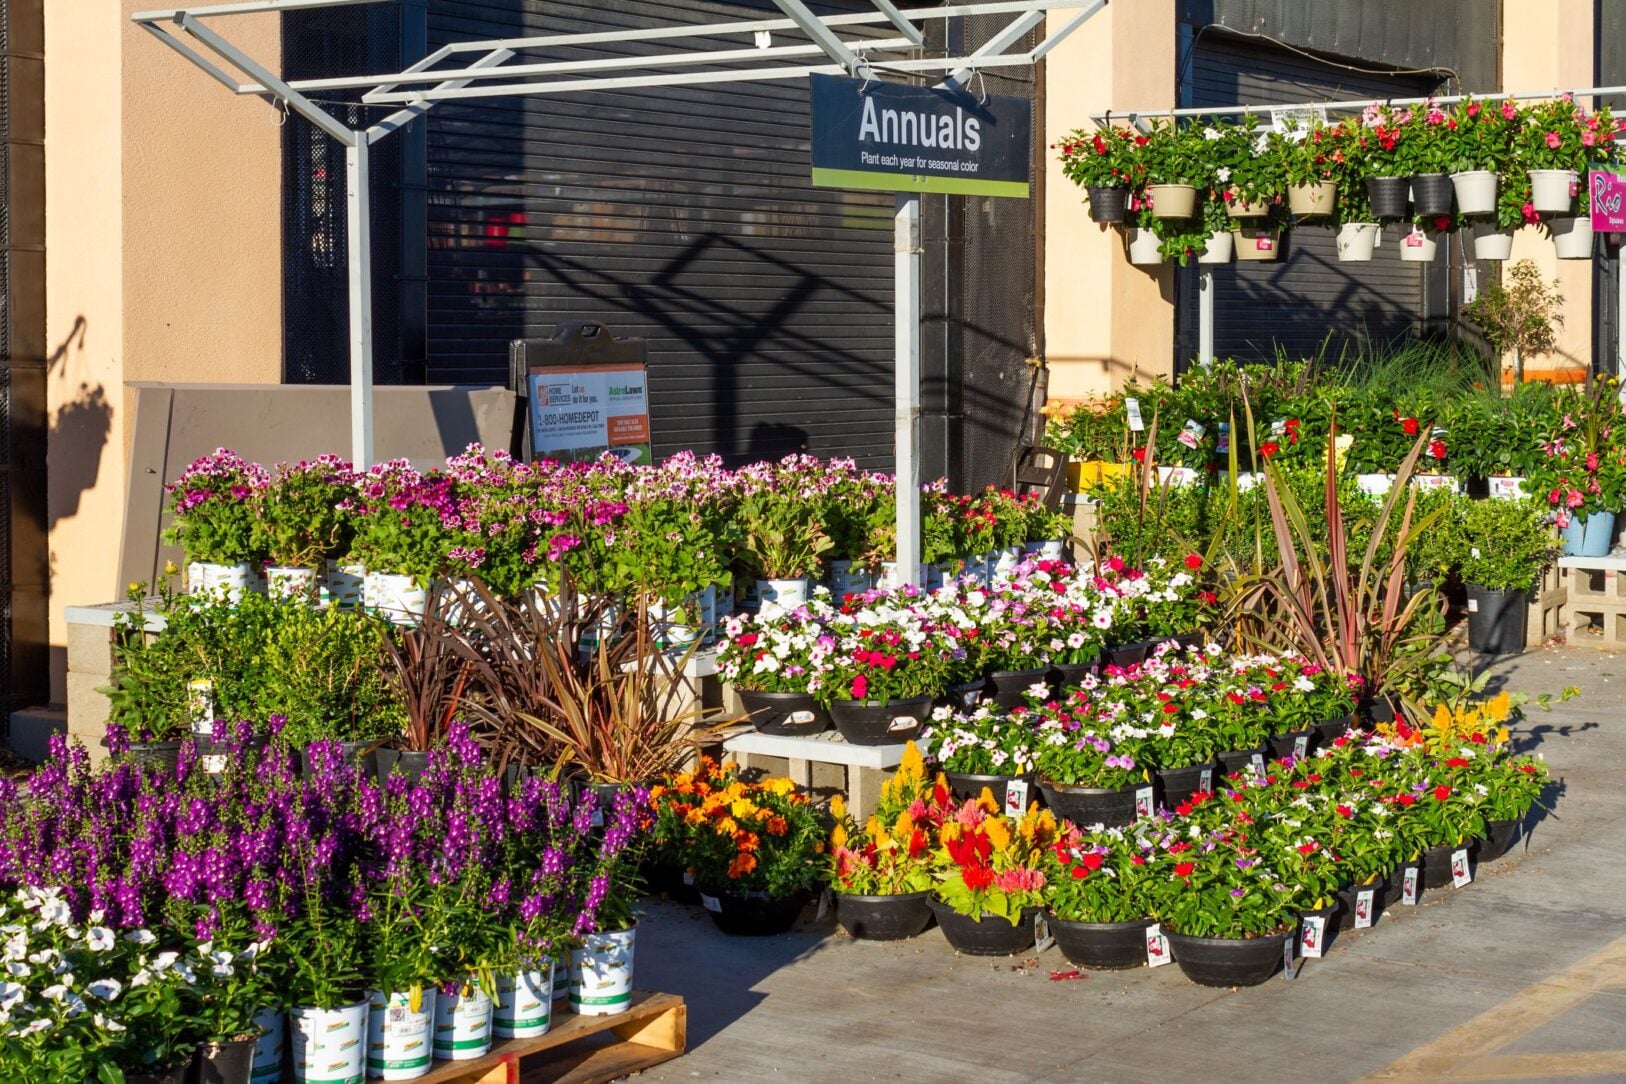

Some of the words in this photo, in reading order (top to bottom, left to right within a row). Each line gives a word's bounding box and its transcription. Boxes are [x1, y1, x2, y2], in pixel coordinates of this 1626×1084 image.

[859, 96, 980, 151] Annuals
[861, 152, 879, 165] Plant
[881, 154, 899, 166] each
[899, 157, 915, 170] year
[916, 156, 927, 168] for
[928, 158, 959, 171] seasonal
[960, 160, 979, 172] color
[1595, 174, 1621, 216] Rio
[549, 395, 571, 403] SERVICES
[608, 386, 643, 396] AstroLawn
[538, 411, 600, 426] 1-800-HOMEDEPOT
